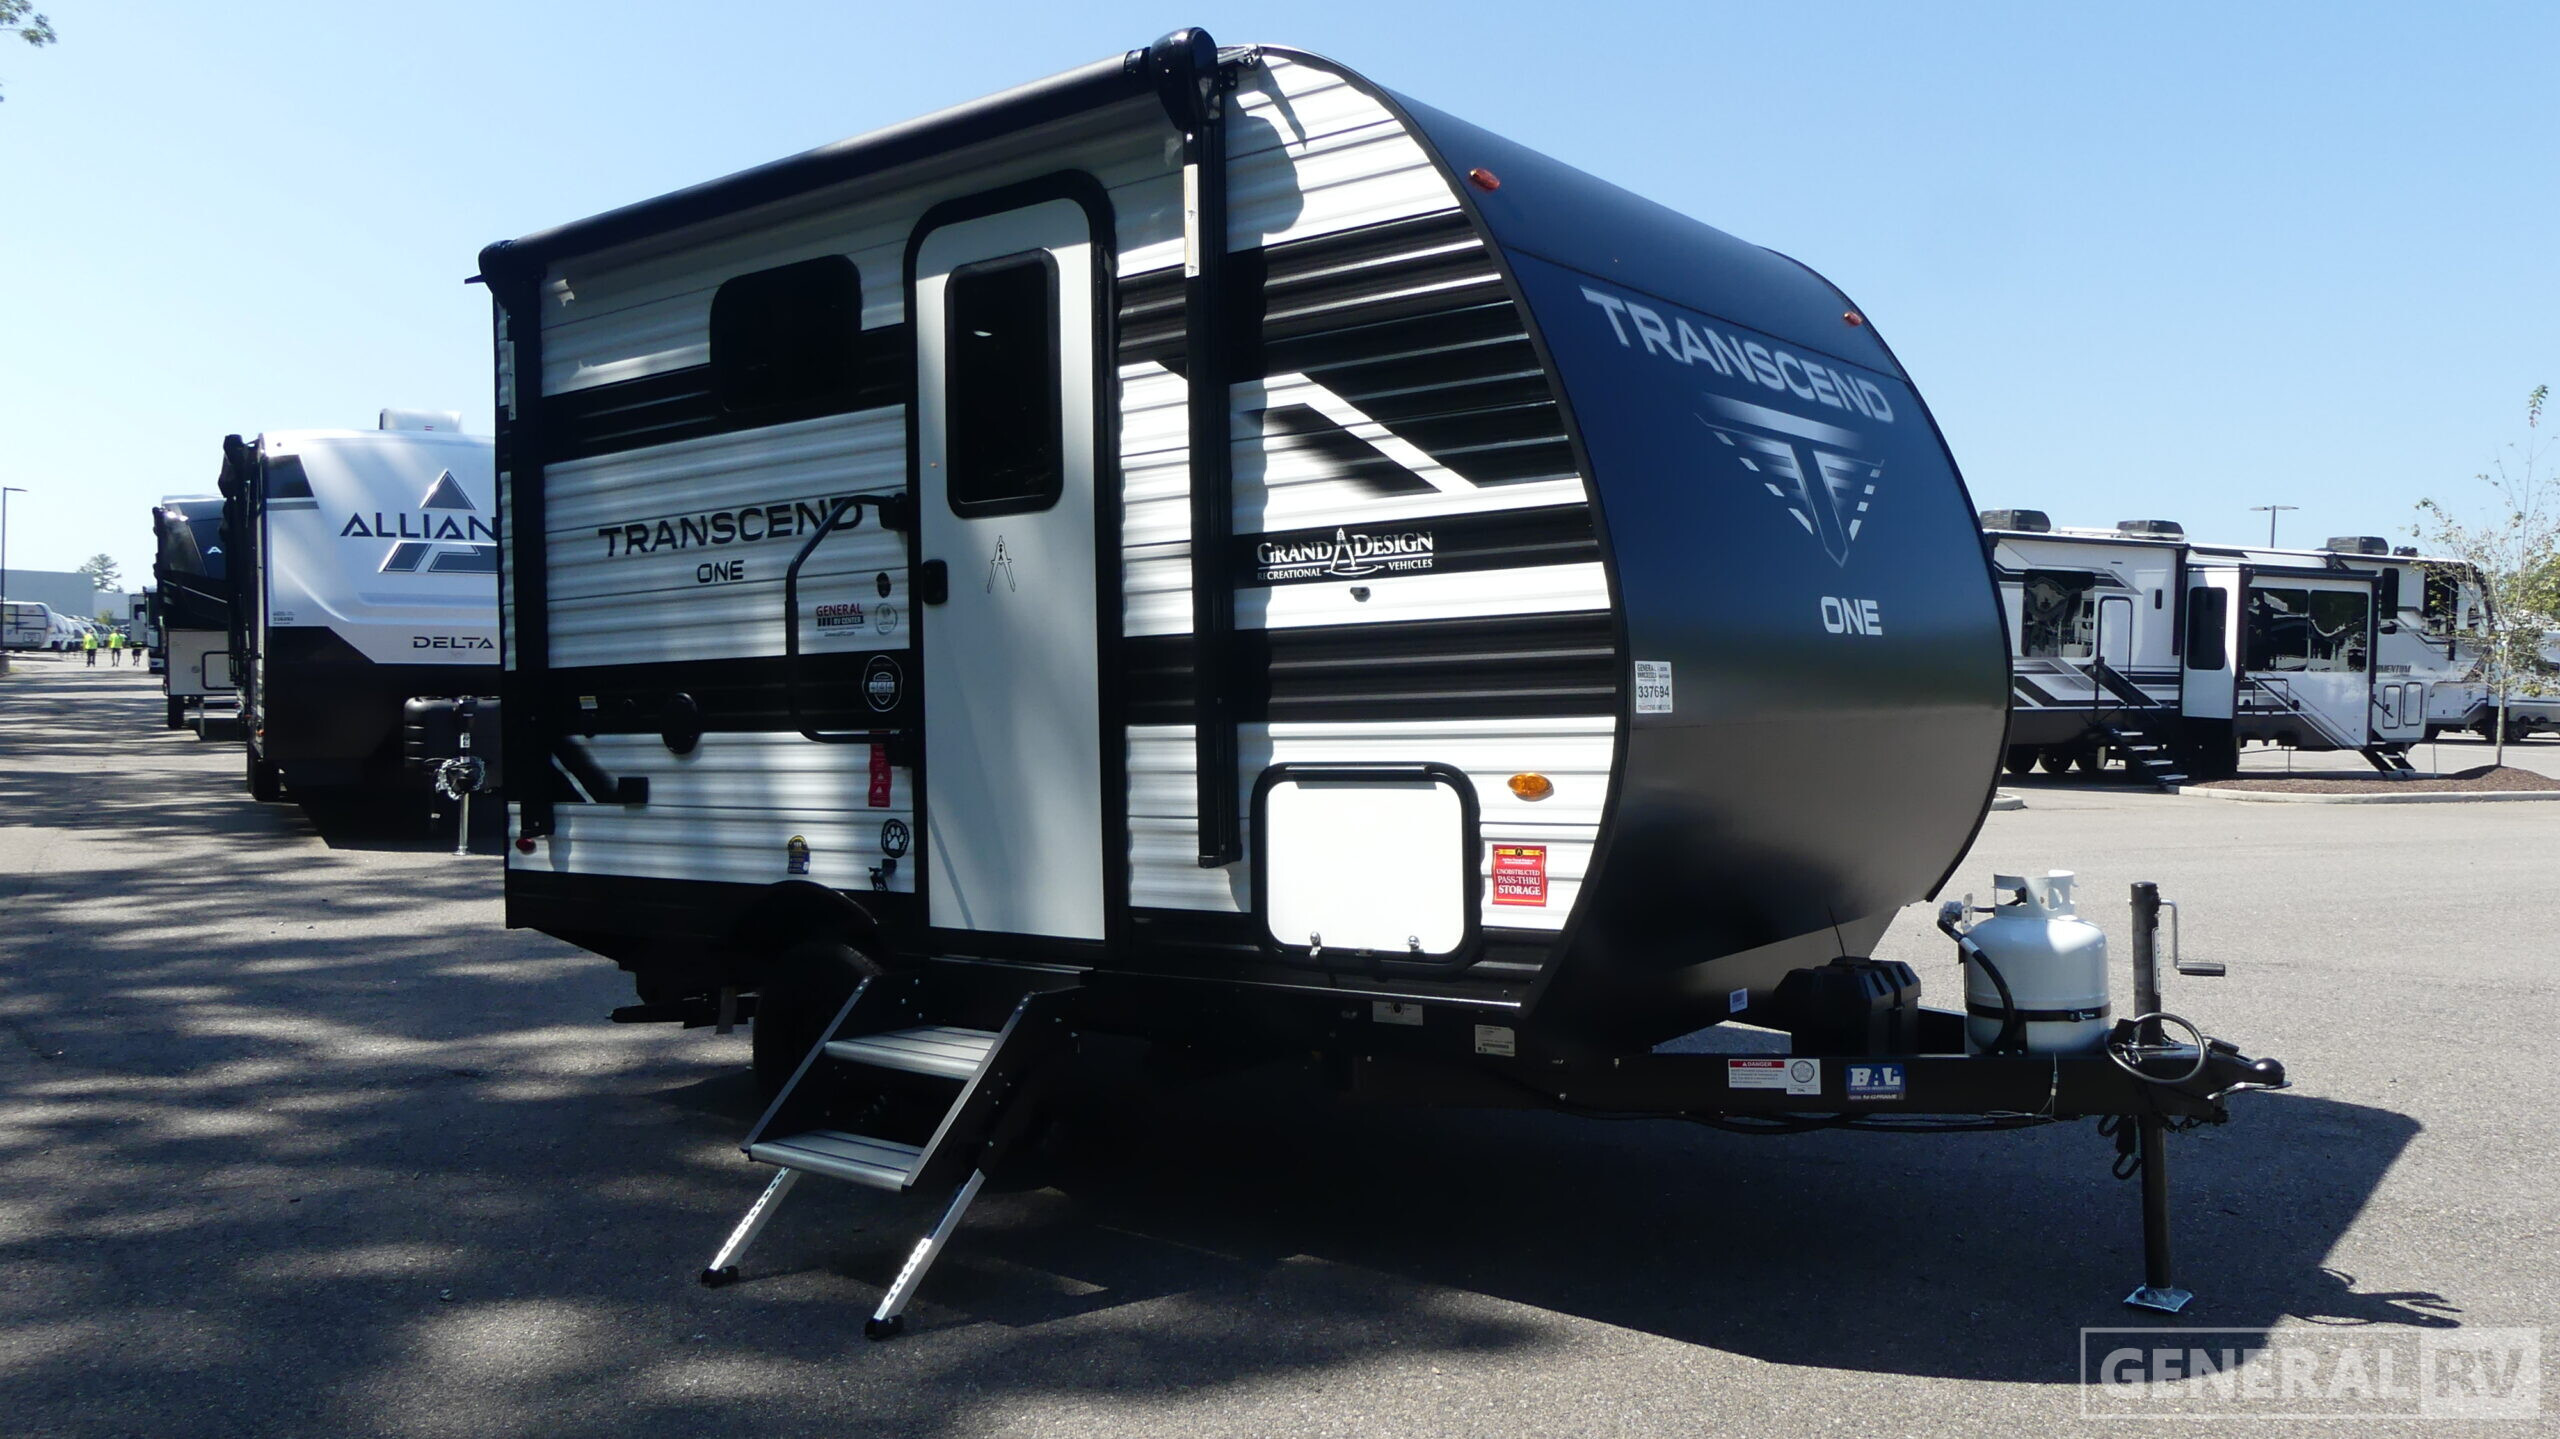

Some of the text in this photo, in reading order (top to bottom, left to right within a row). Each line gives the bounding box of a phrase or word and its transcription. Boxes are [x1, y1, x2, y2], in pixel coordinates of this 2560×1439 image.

[1579, 286, 1894, 423] TRANSCEND
[598, 497, 863, 558] TRANSCEND
[1256, 531, 1434, 565] GRAND DESIGN
[696, 559, 745, 584] ONE
[1256, 558, 1433, 581] RECREATIONAL VEHICLES
[816, 603, 863, 617] GENERAL
[1820, 596, 1883, 636] ONE
[412, 636, 495, 650] DELTA
[1637, 685, 1670, 698] 337694
[1497, 875, 1540, 885] PASS-THRU
[1498, 884, 1542, 896] STORAGE
[1850, 1067, 1901, 1086] BAL
